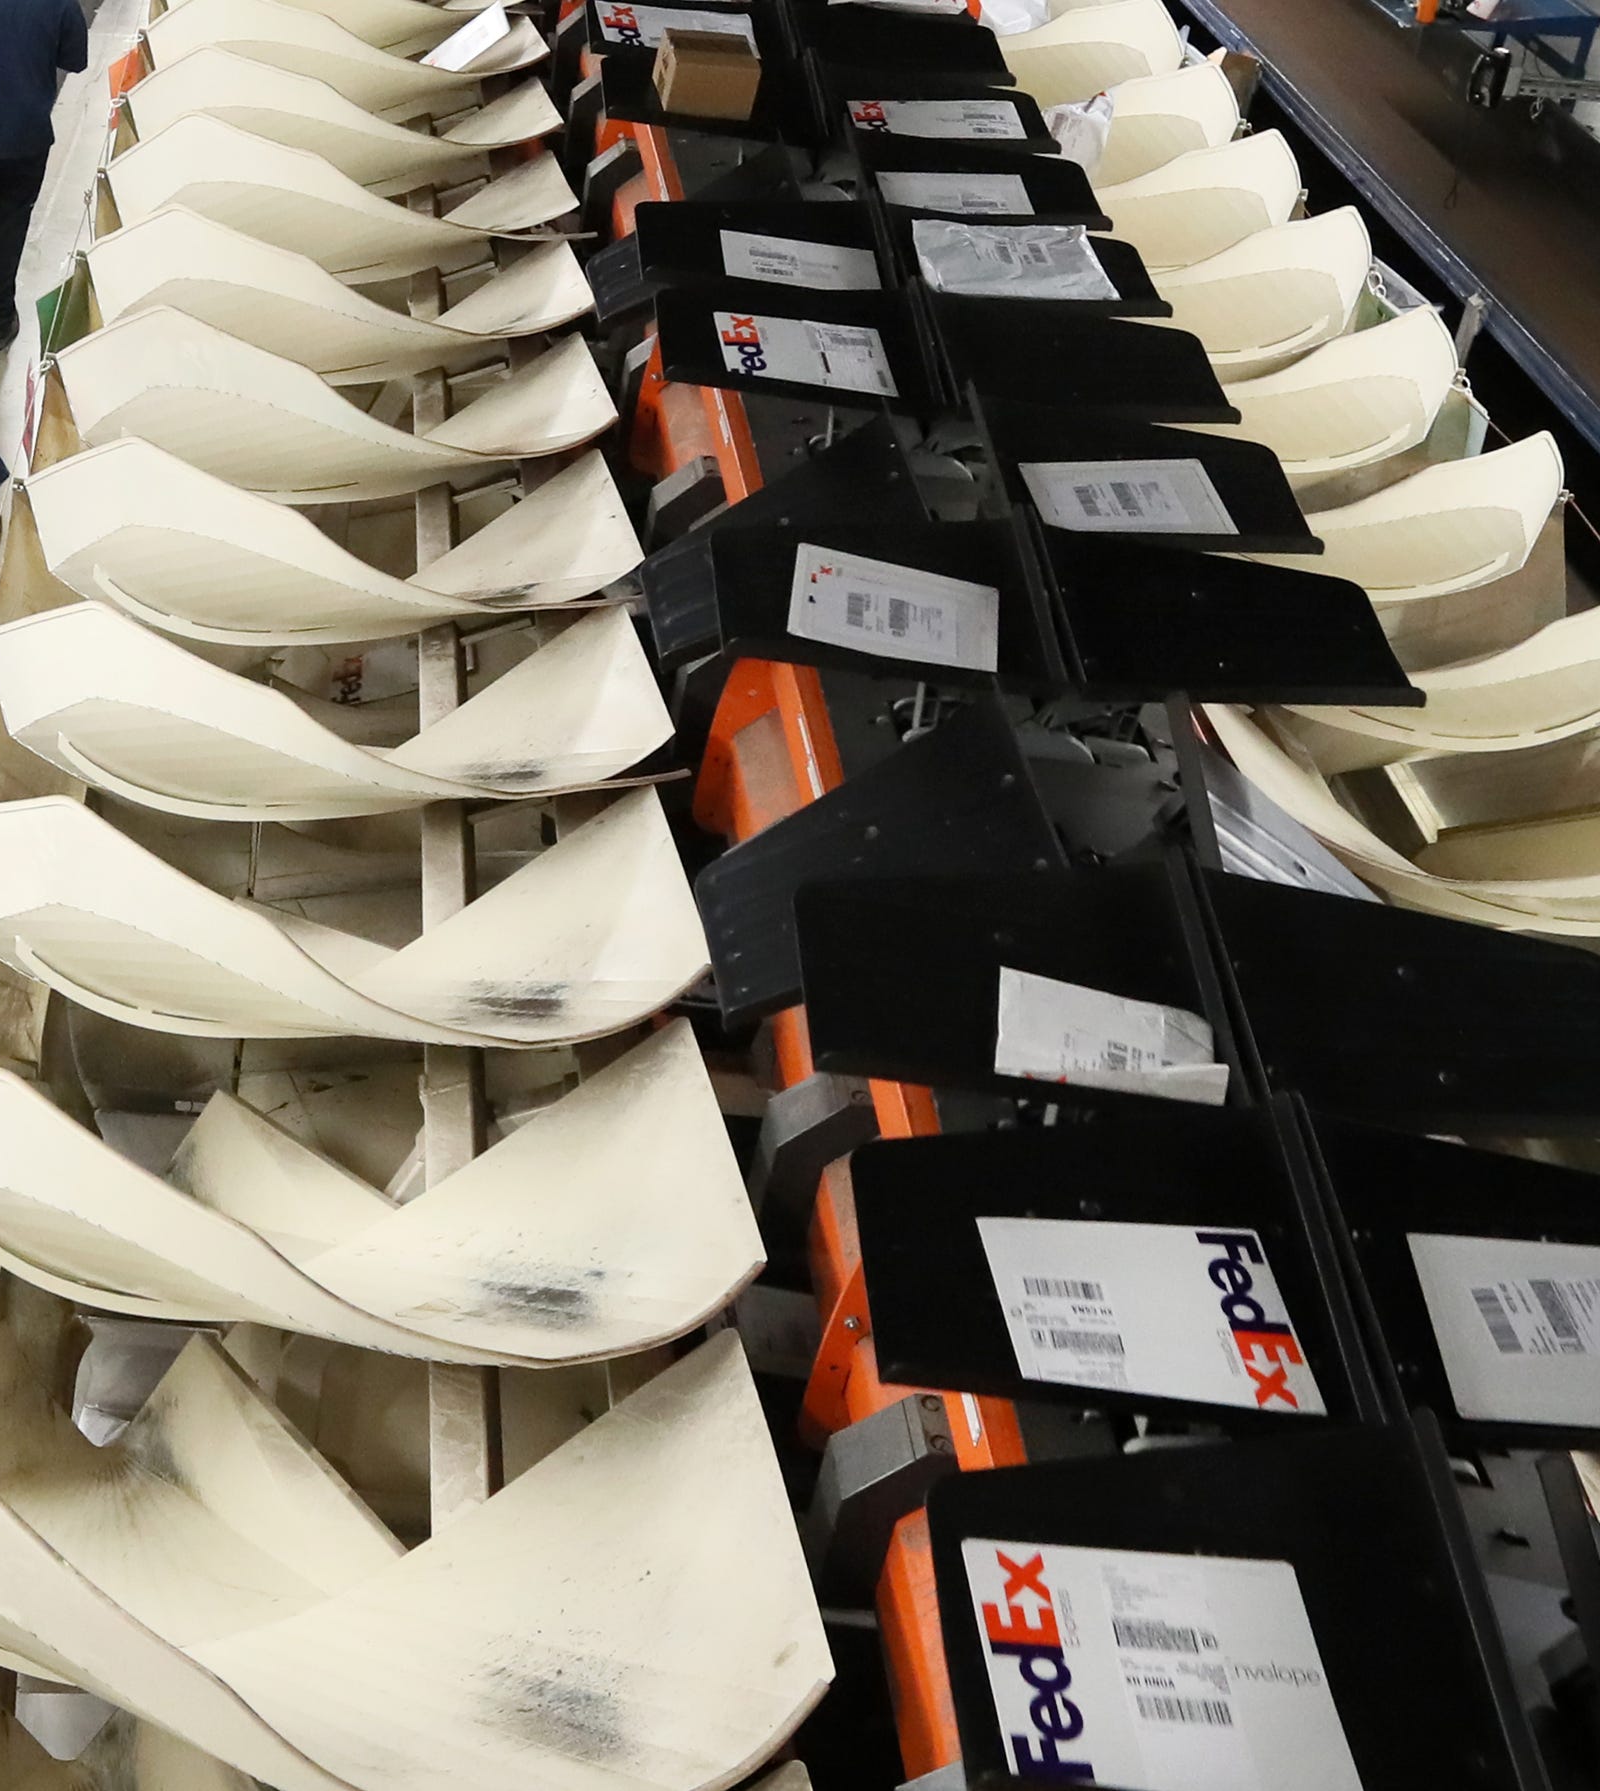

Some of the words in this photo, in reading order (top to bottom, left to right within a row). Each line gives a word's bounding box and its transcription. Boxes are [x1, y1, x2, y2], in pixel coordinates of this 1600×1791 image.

[603, 5, 645, 47] edEx
[853, 101, 892, 133] dEx
[330, 654, 363, 704] FedE
[1195, 1231, 1304, 1409] FedEx
[982, 1550, 1096, 1784] FedEx
[1231, 1659, 1322, 1688] nvelope
